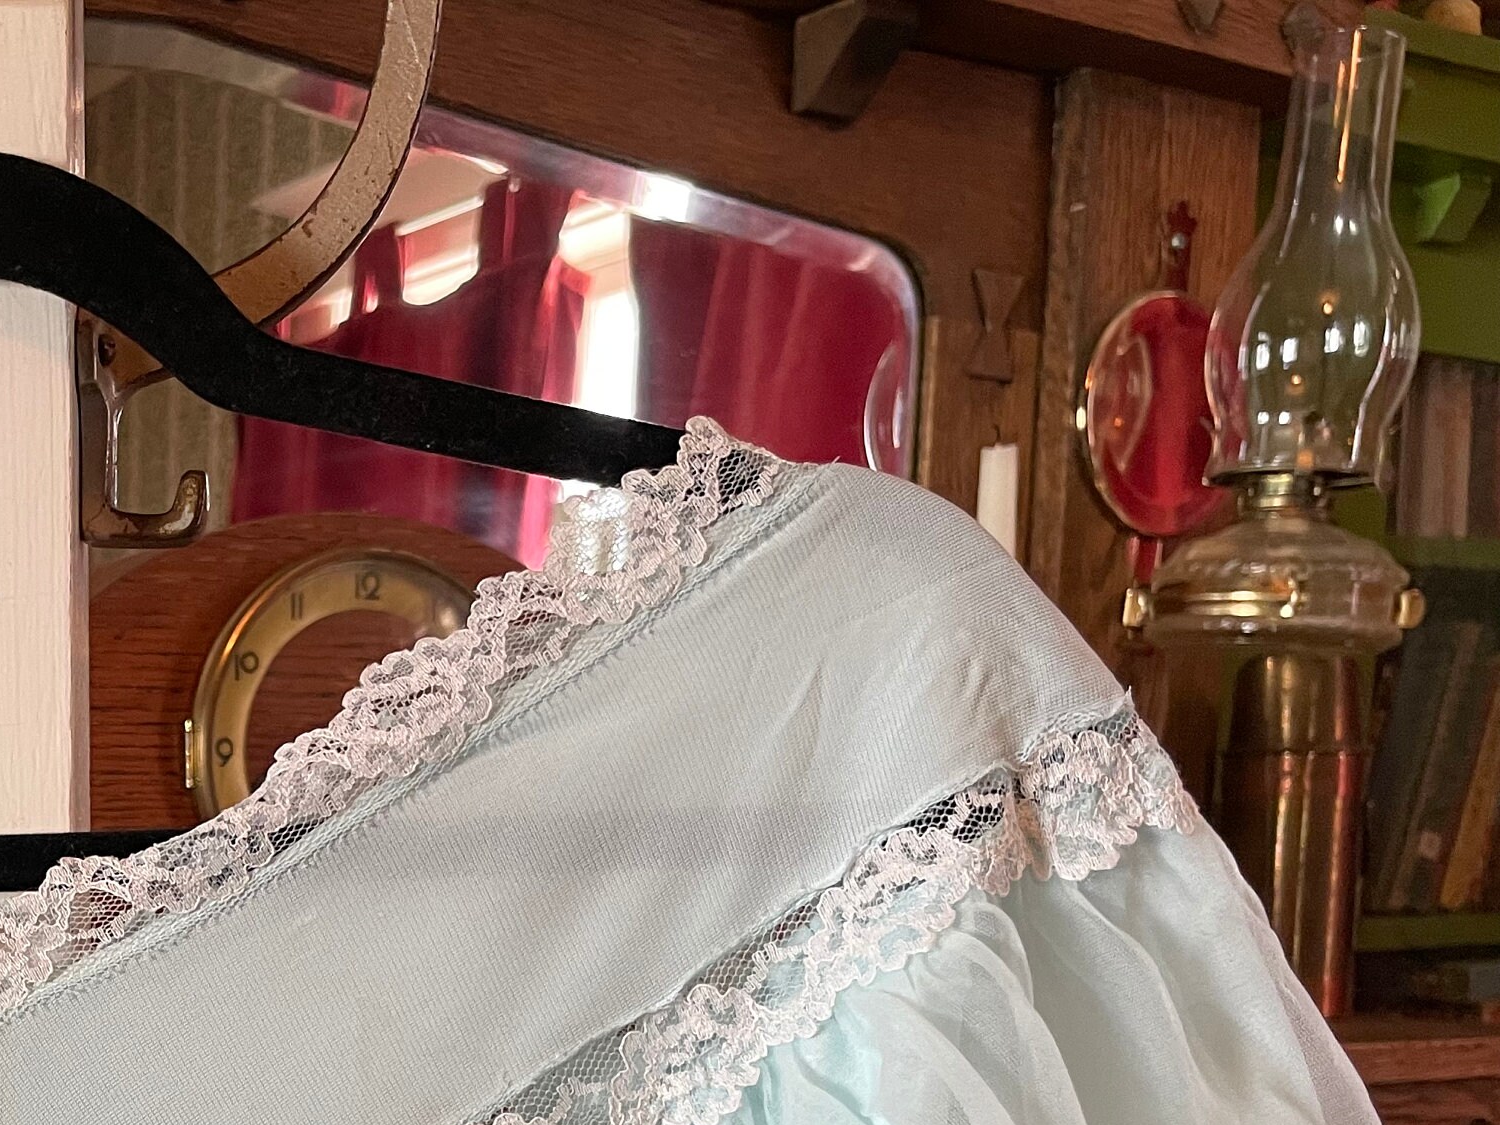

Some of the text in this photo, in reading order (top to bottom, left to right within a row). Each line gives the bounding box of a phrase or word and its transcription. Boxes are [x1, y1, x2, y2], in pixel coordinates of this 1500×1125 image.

[355, 571, 380, 600] 12
[291, 593, 303, 621] 11
[234, 652, 260, 682] 10
[215, 737, 234, 767] 9
